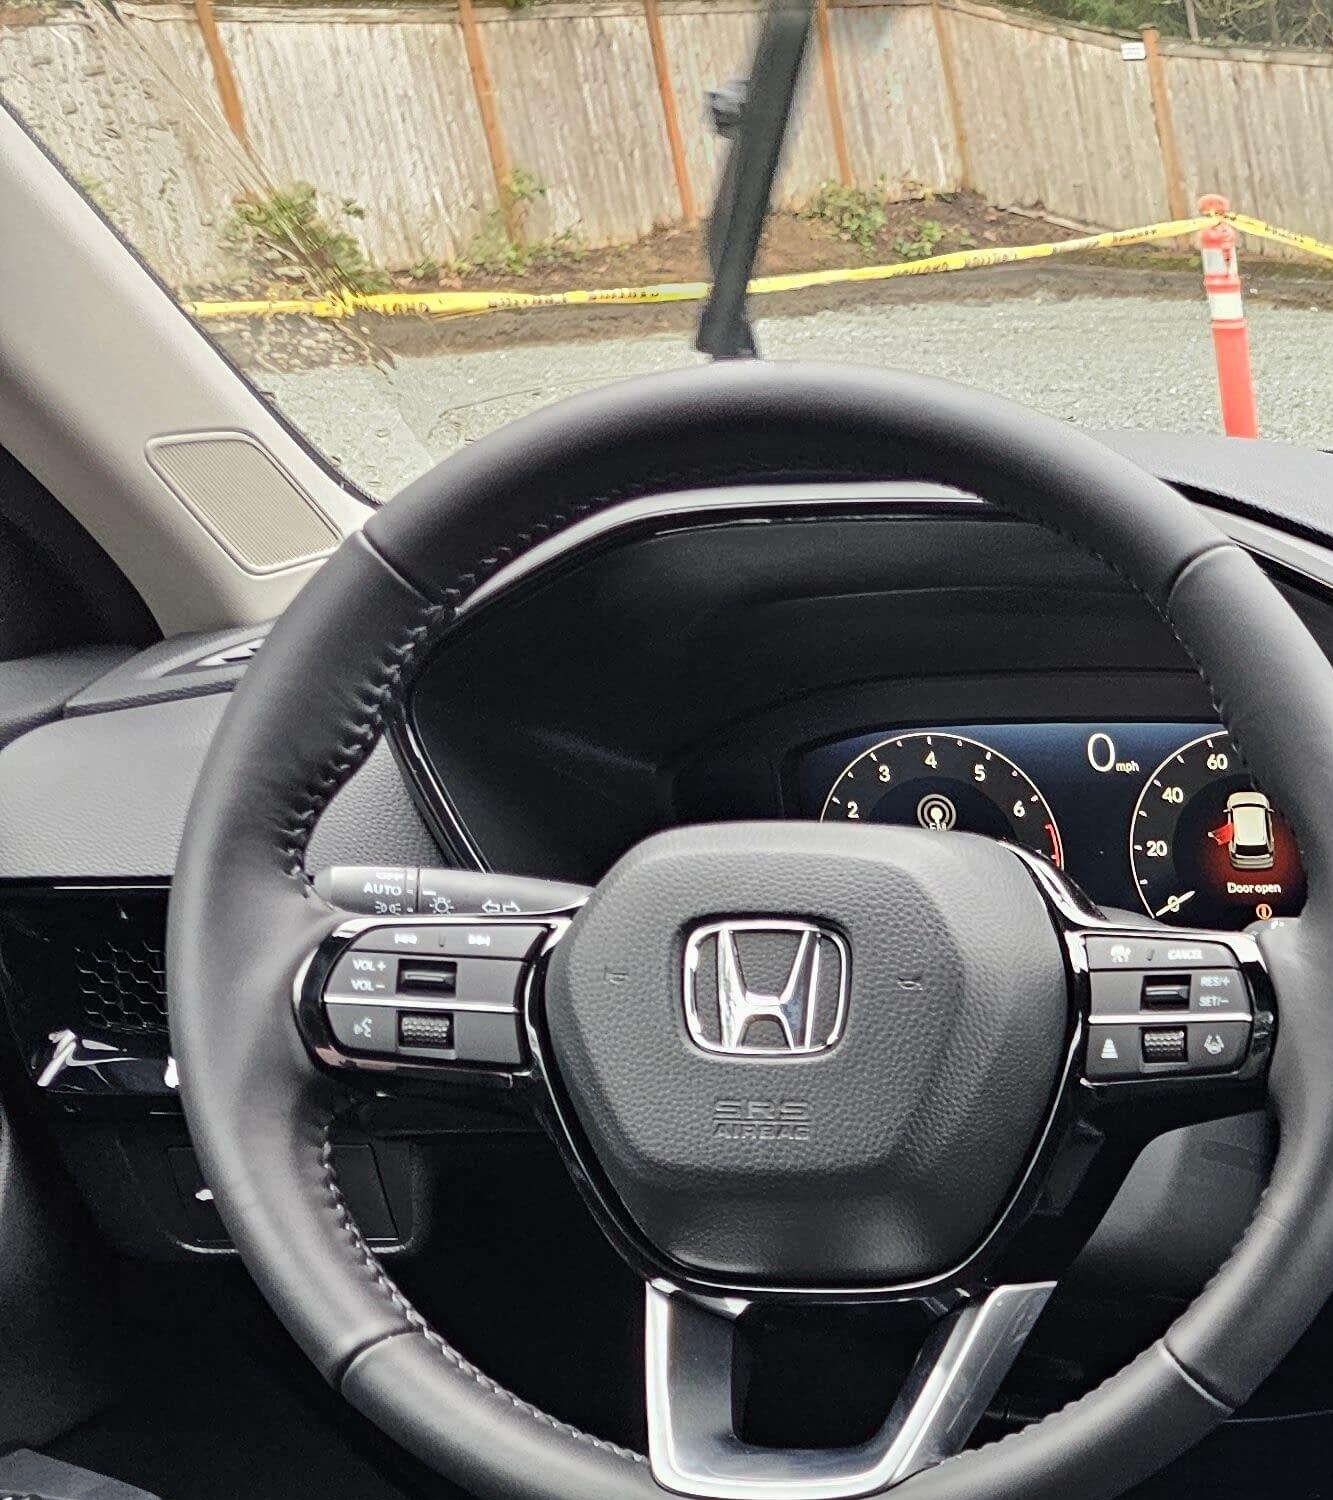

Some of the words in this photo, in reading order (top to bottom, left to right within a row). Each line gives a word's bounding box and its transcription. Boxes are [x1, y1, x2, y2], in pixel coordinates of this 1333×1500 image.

[925, 751, 938, 768] 4
[1087, 733, 1116, 773] 0
[1116, 761, 1140, 774] mph
[1207, 754, 1228, 770] 60
[878, 765, 890, 782] 3
[974, 764, 986, 782] 5
[1162, 787, 1184, 803] 40
[847, 802, 859, 819] 2
[1013, 800, 1025, 817] 6
[1146, 841, 1167, 856] 20
[363, 882, 401, 896] AUTO
[1227, 883, 1254, 894] Door
[1255, 884, 1282, 895] open
[1168, 949, 1203, 960] CANCEL
[713, 1100, 809, 1120] SRS
